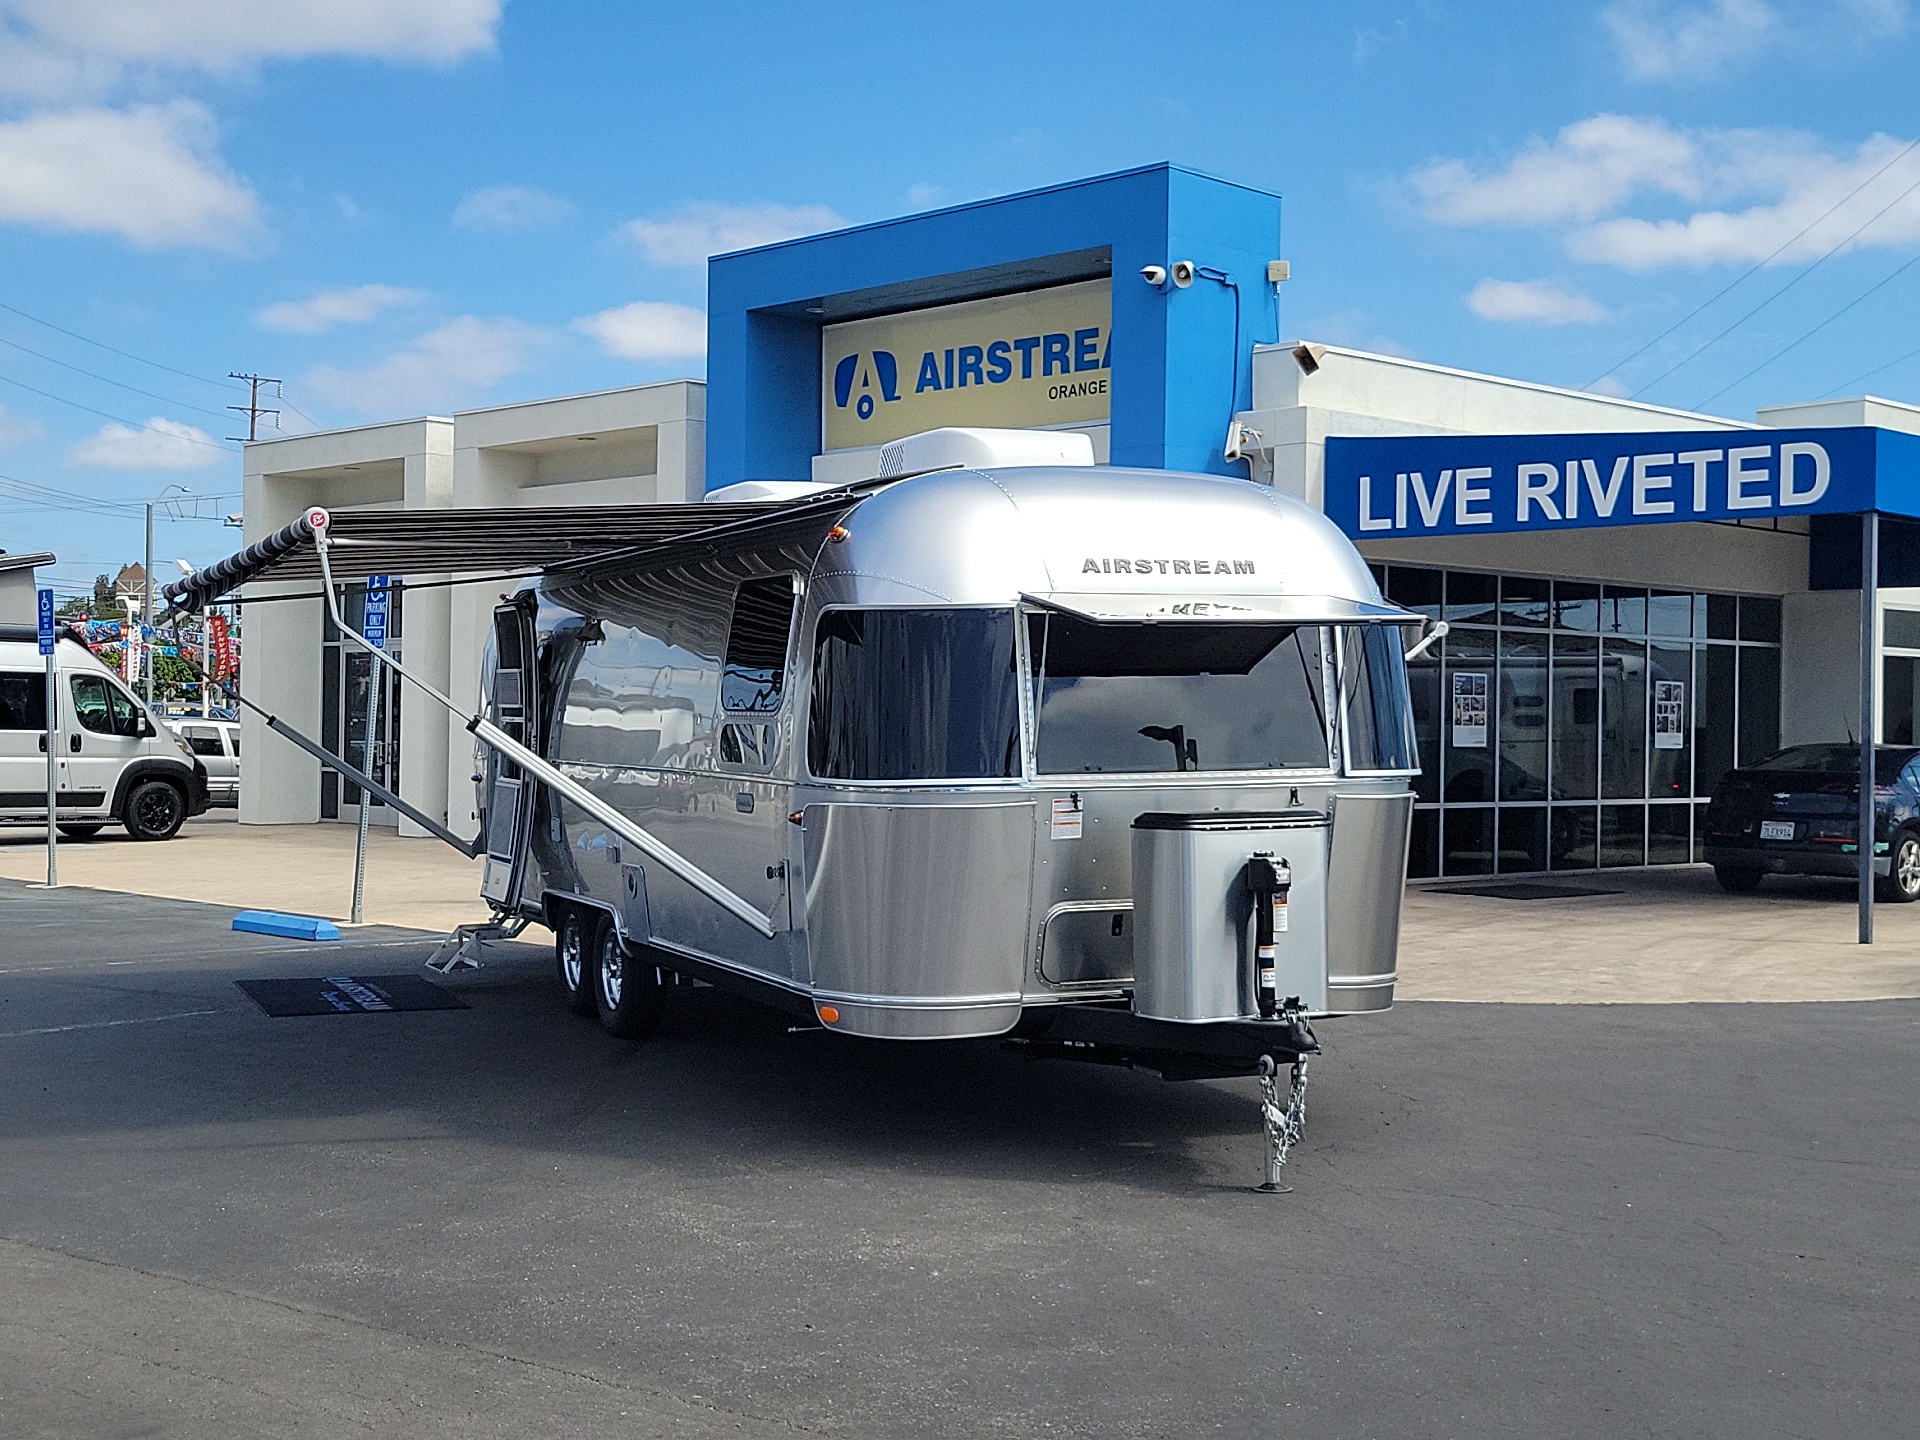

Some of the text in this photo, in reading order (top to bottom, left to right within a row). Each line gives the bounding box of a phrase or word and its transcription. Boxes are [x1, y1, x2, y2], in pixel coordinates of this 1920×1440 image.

[1048, 379, 1108, 400] ORANGE
[1359, 441, 1831, 531] LIVE RIVETED
[1081, 558, 1256, 575] AIRSTREAM
